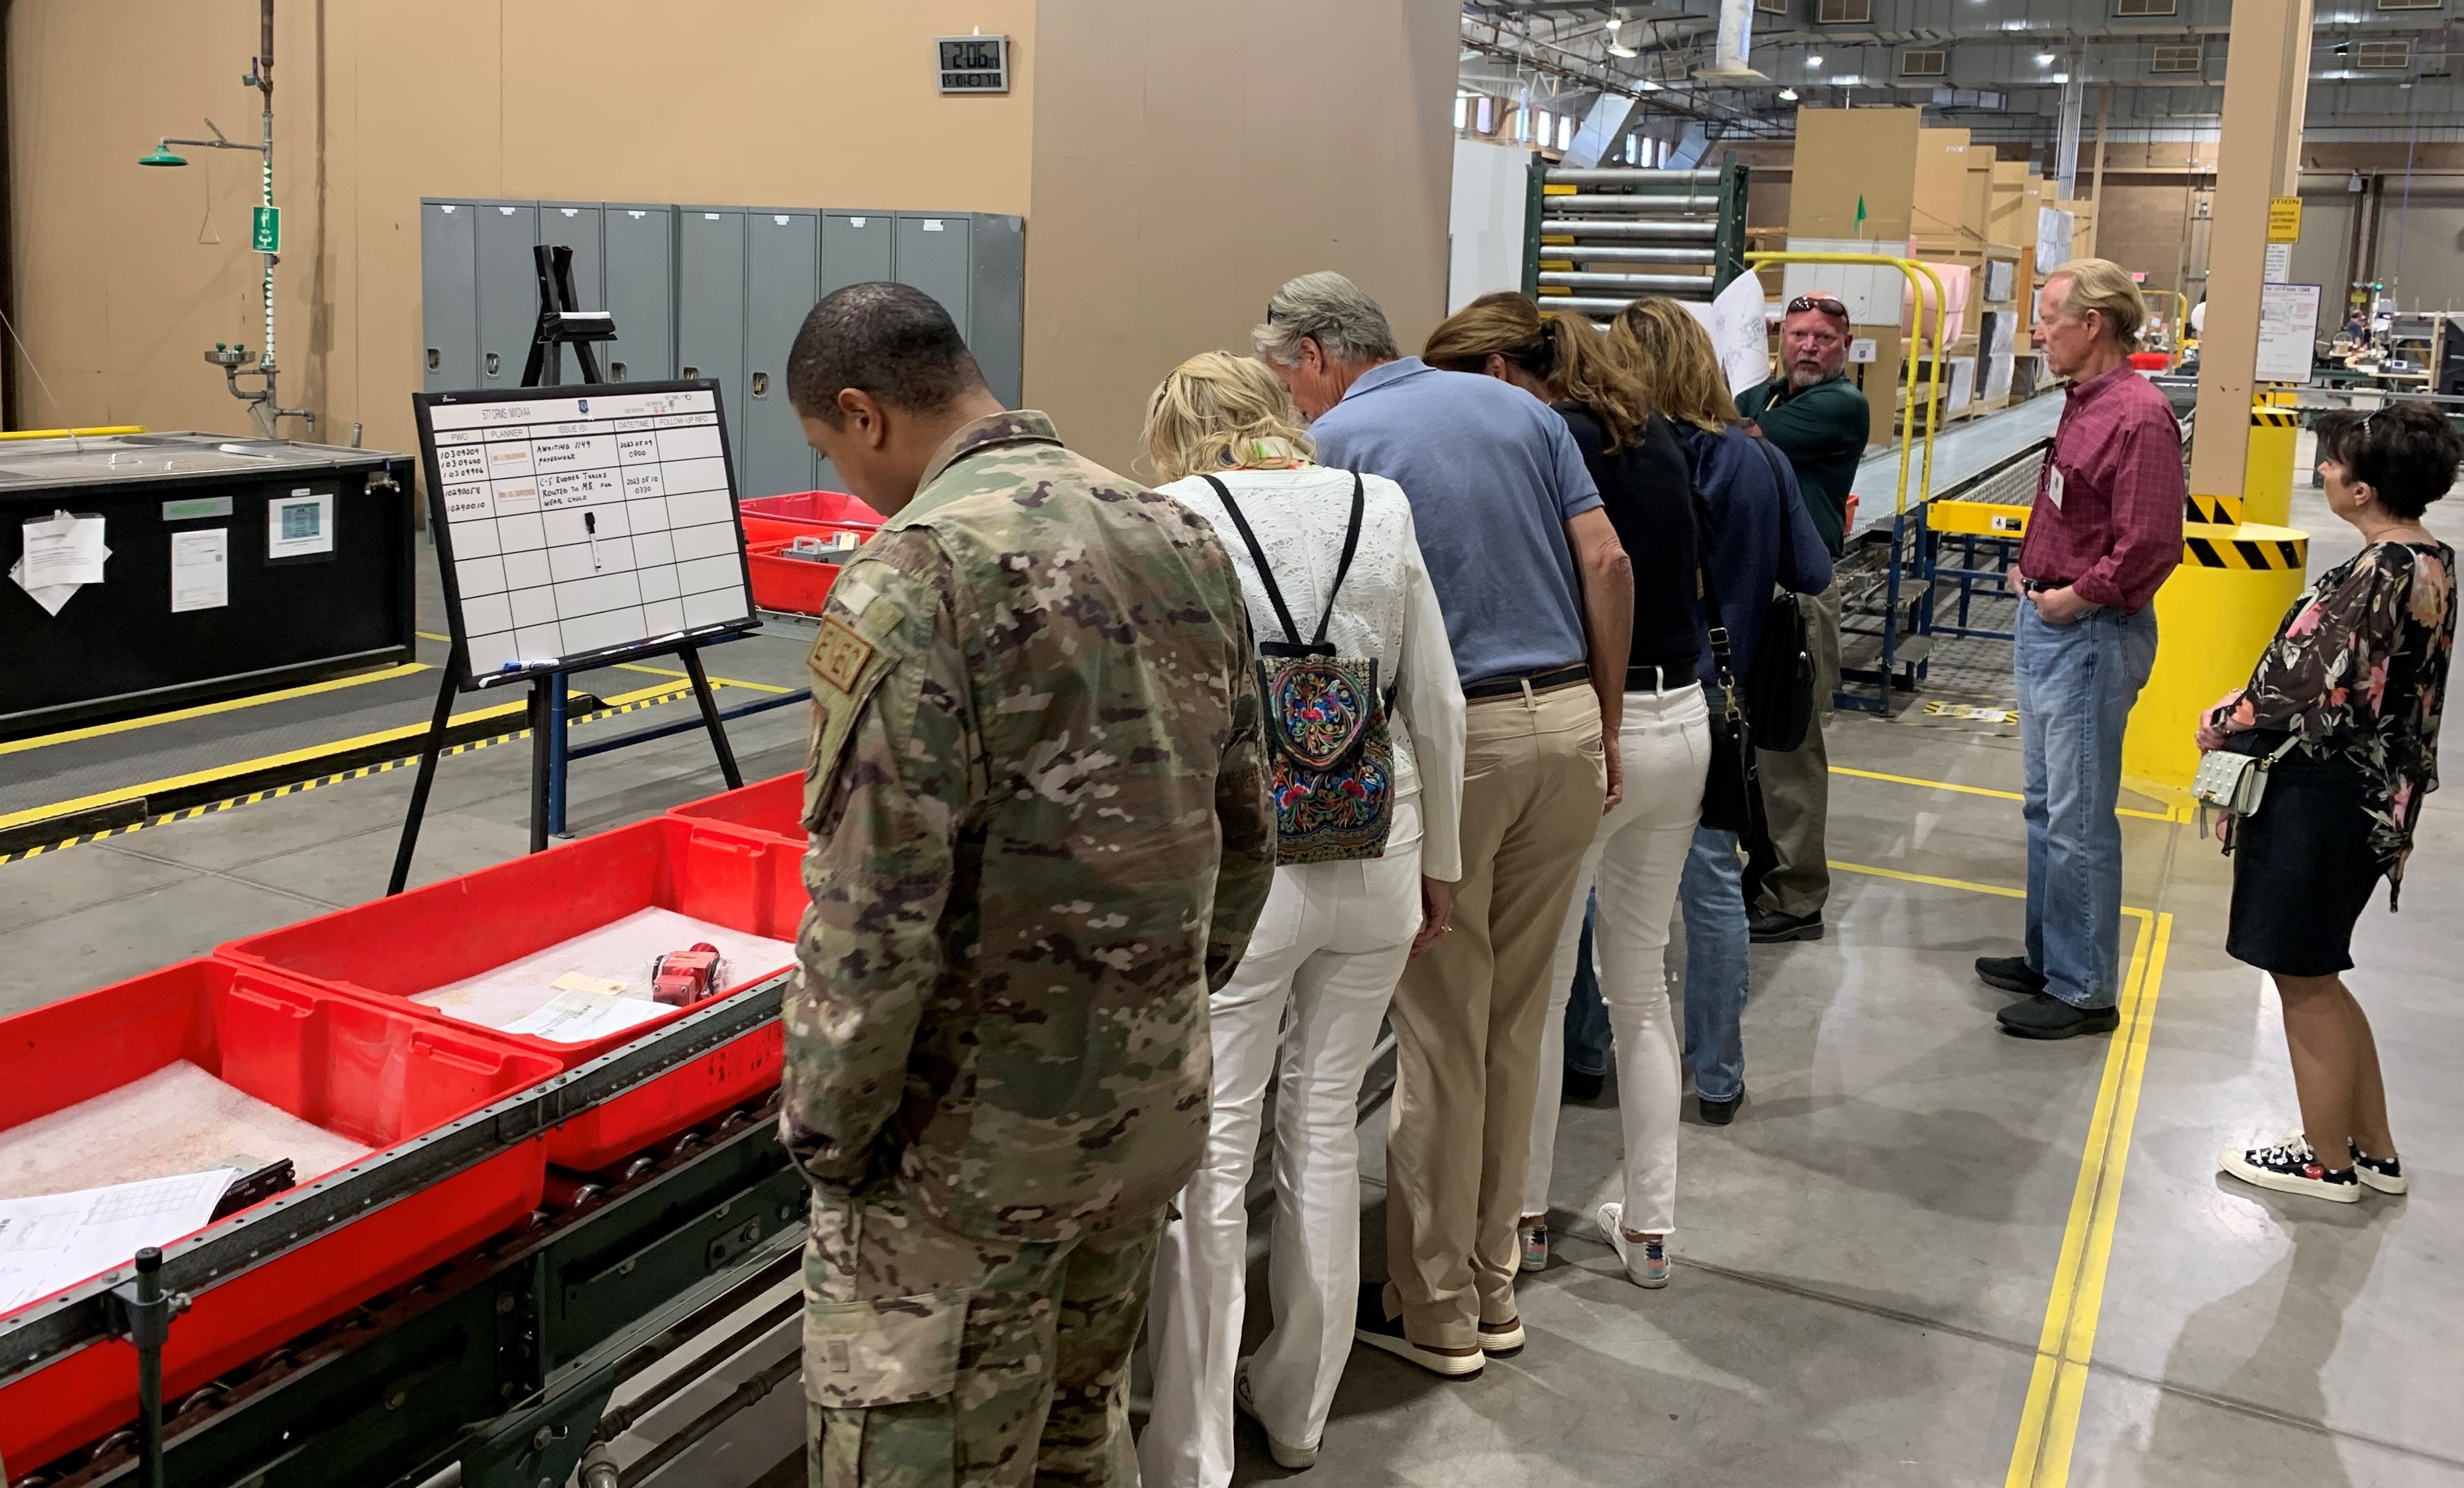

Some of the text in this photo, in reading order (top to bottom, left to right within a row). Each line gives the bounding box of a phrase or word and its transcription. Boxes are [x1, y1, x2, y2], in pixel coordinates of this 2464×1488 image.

[619, 420, 649, 429] DATE/TIME
[659, 415, 708, 426] FOLLOW-UP INFO
[491, 428, 523, 438] PLANNER
[558, 424, 578, 434] ISSUE
[451, 432, 469, 442] PWO
[537, 440, 591, 453] AWAITING 1149
[542, 488, 568, 498] ROUTED
[544, 498, 562, 507] WEAR
